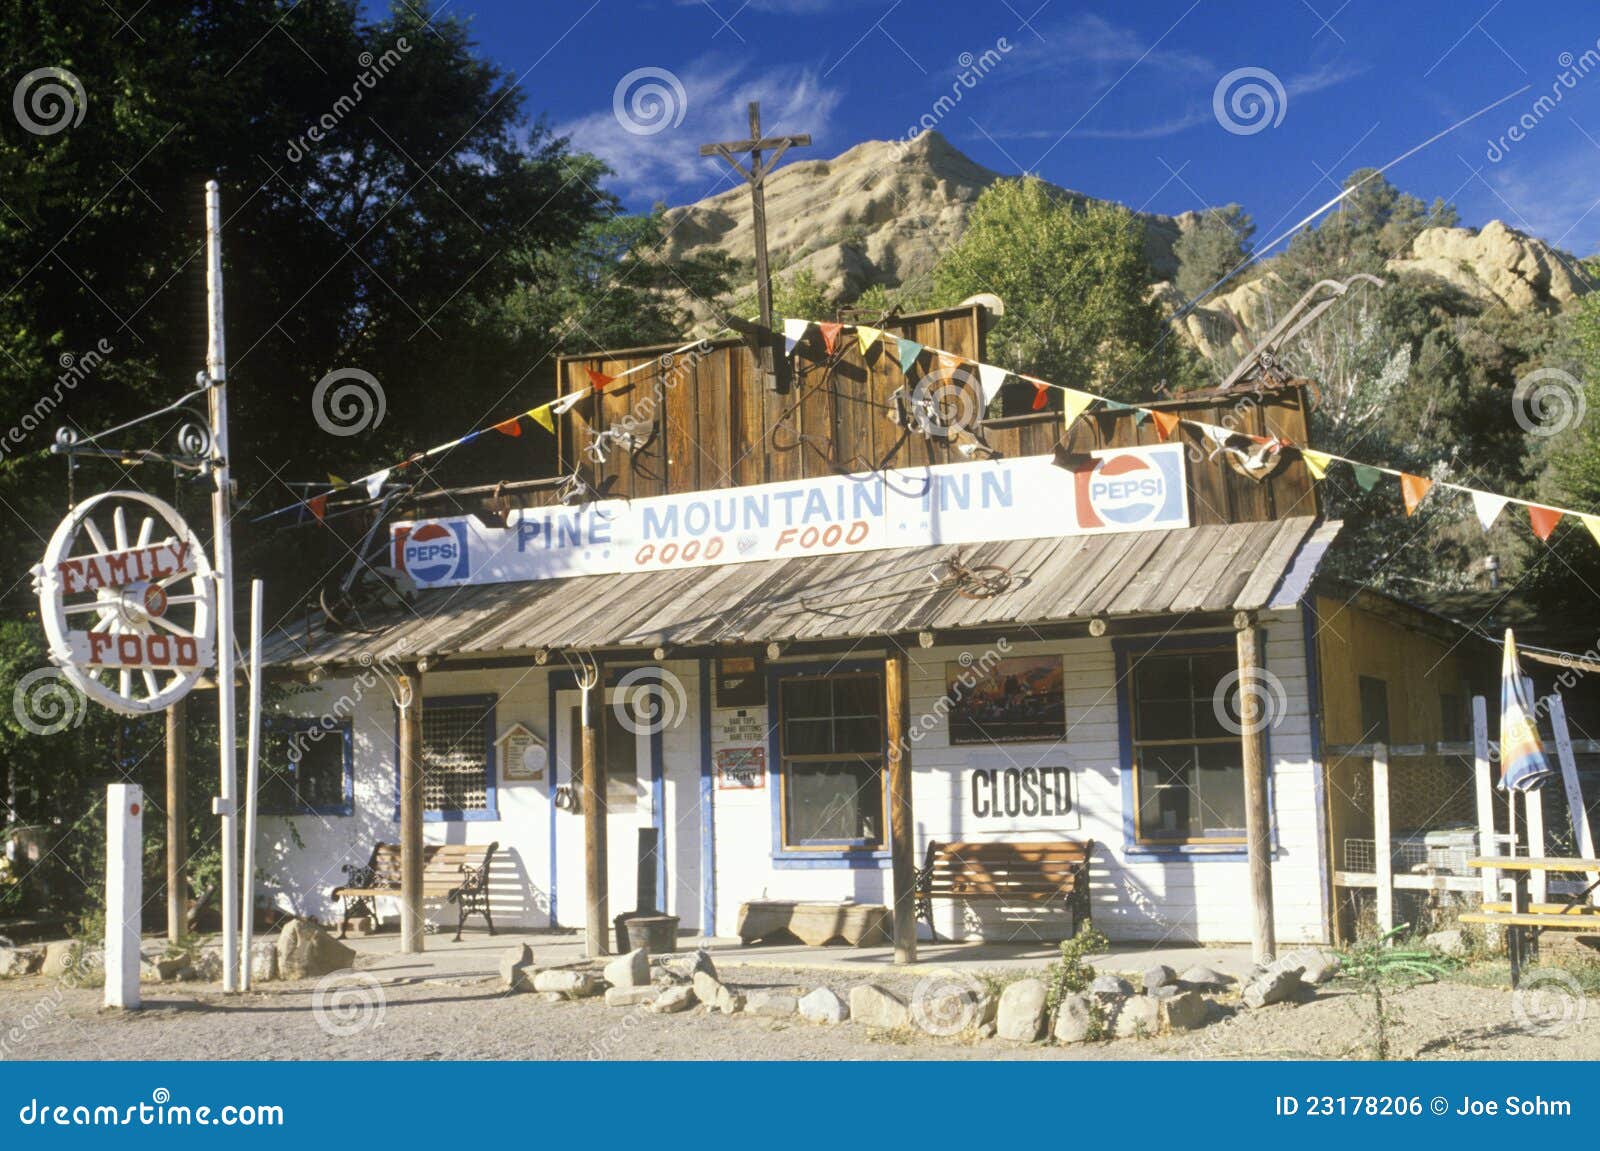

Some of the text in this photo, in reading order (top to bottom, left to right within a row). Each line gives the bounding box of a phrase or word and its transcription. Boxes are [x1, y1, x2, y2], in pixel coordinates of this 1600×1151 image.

[517, 468, 1014, 552] PINE MOUNTAIN INN
[1091, 477, 1163, 501] PEPSI
[405, 541, 458, 563] PEPSI
[635, 521, 869, 565] GOOD FOOD
[57, 541, 191, 595] FAMILY
[87, 631, 198, 667] FOOD
[972, 766, 1072, 818] CLOSED
